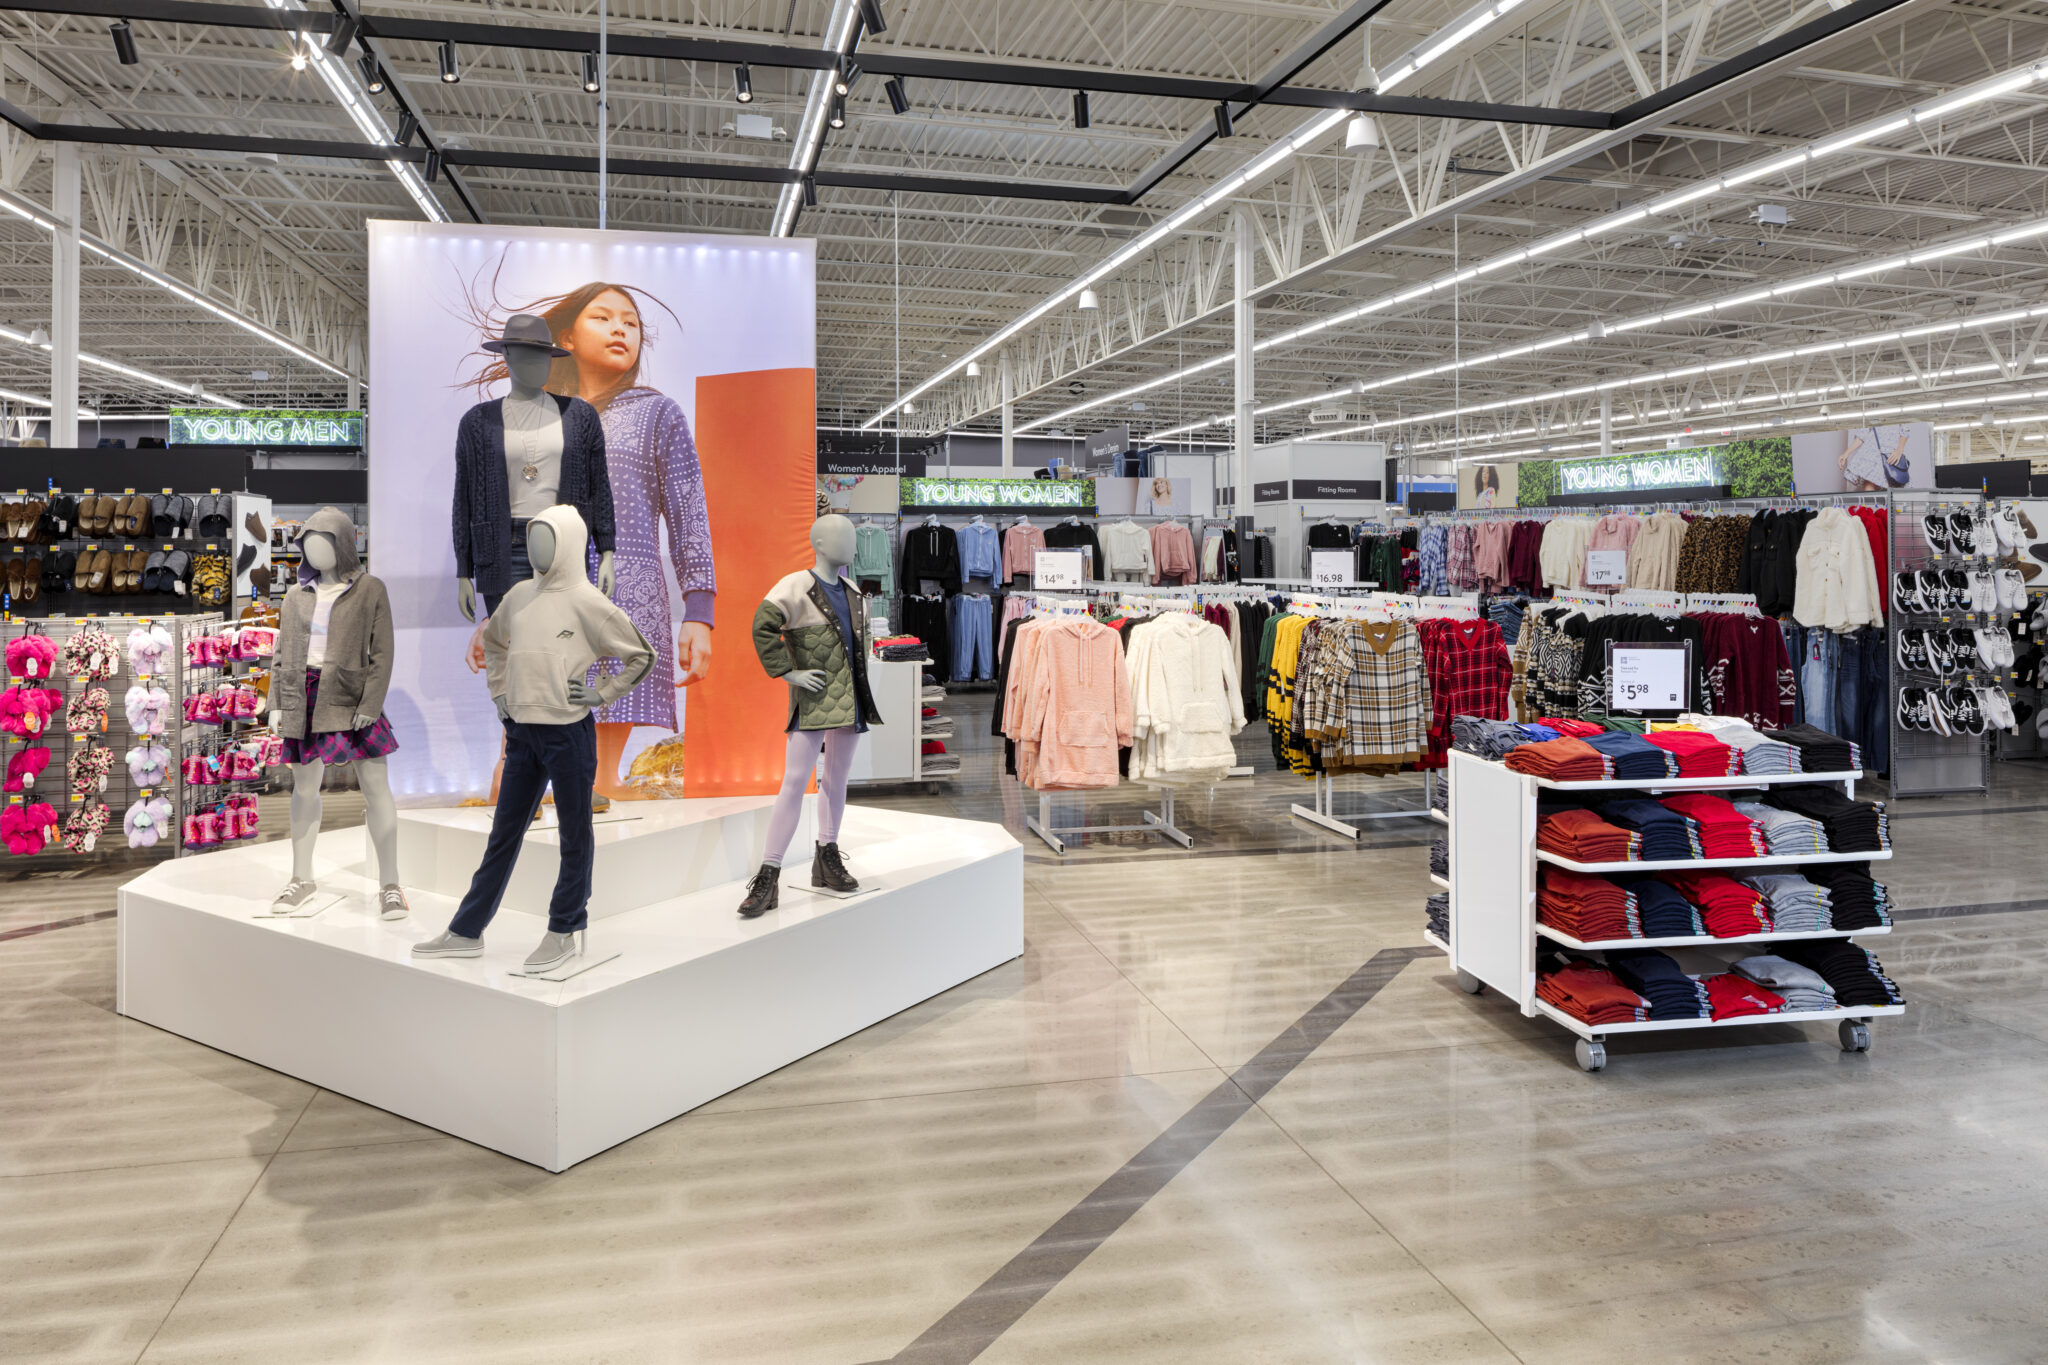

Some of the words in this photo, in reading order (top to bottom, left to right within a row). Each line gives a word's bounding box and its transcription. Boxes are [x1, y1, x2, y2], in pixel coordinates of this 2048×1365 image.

[183, 418, 284, 442] YOUNG
[290, 419, 350, 443] MEN
[828, 463, 869, 473] Women's
[870, 464, 906, 476] Apparel
[1562, 463, 1628, 490] YOUNG
[1631, 455, 1711, 486] WOMEN
[919, 484, 995, 504] YOUNG
[999, 484, 1080, 504] WOMEN
[1317, 486, 1337, 495] Fitting
[1337, 486, 1357, 494] Rooms
